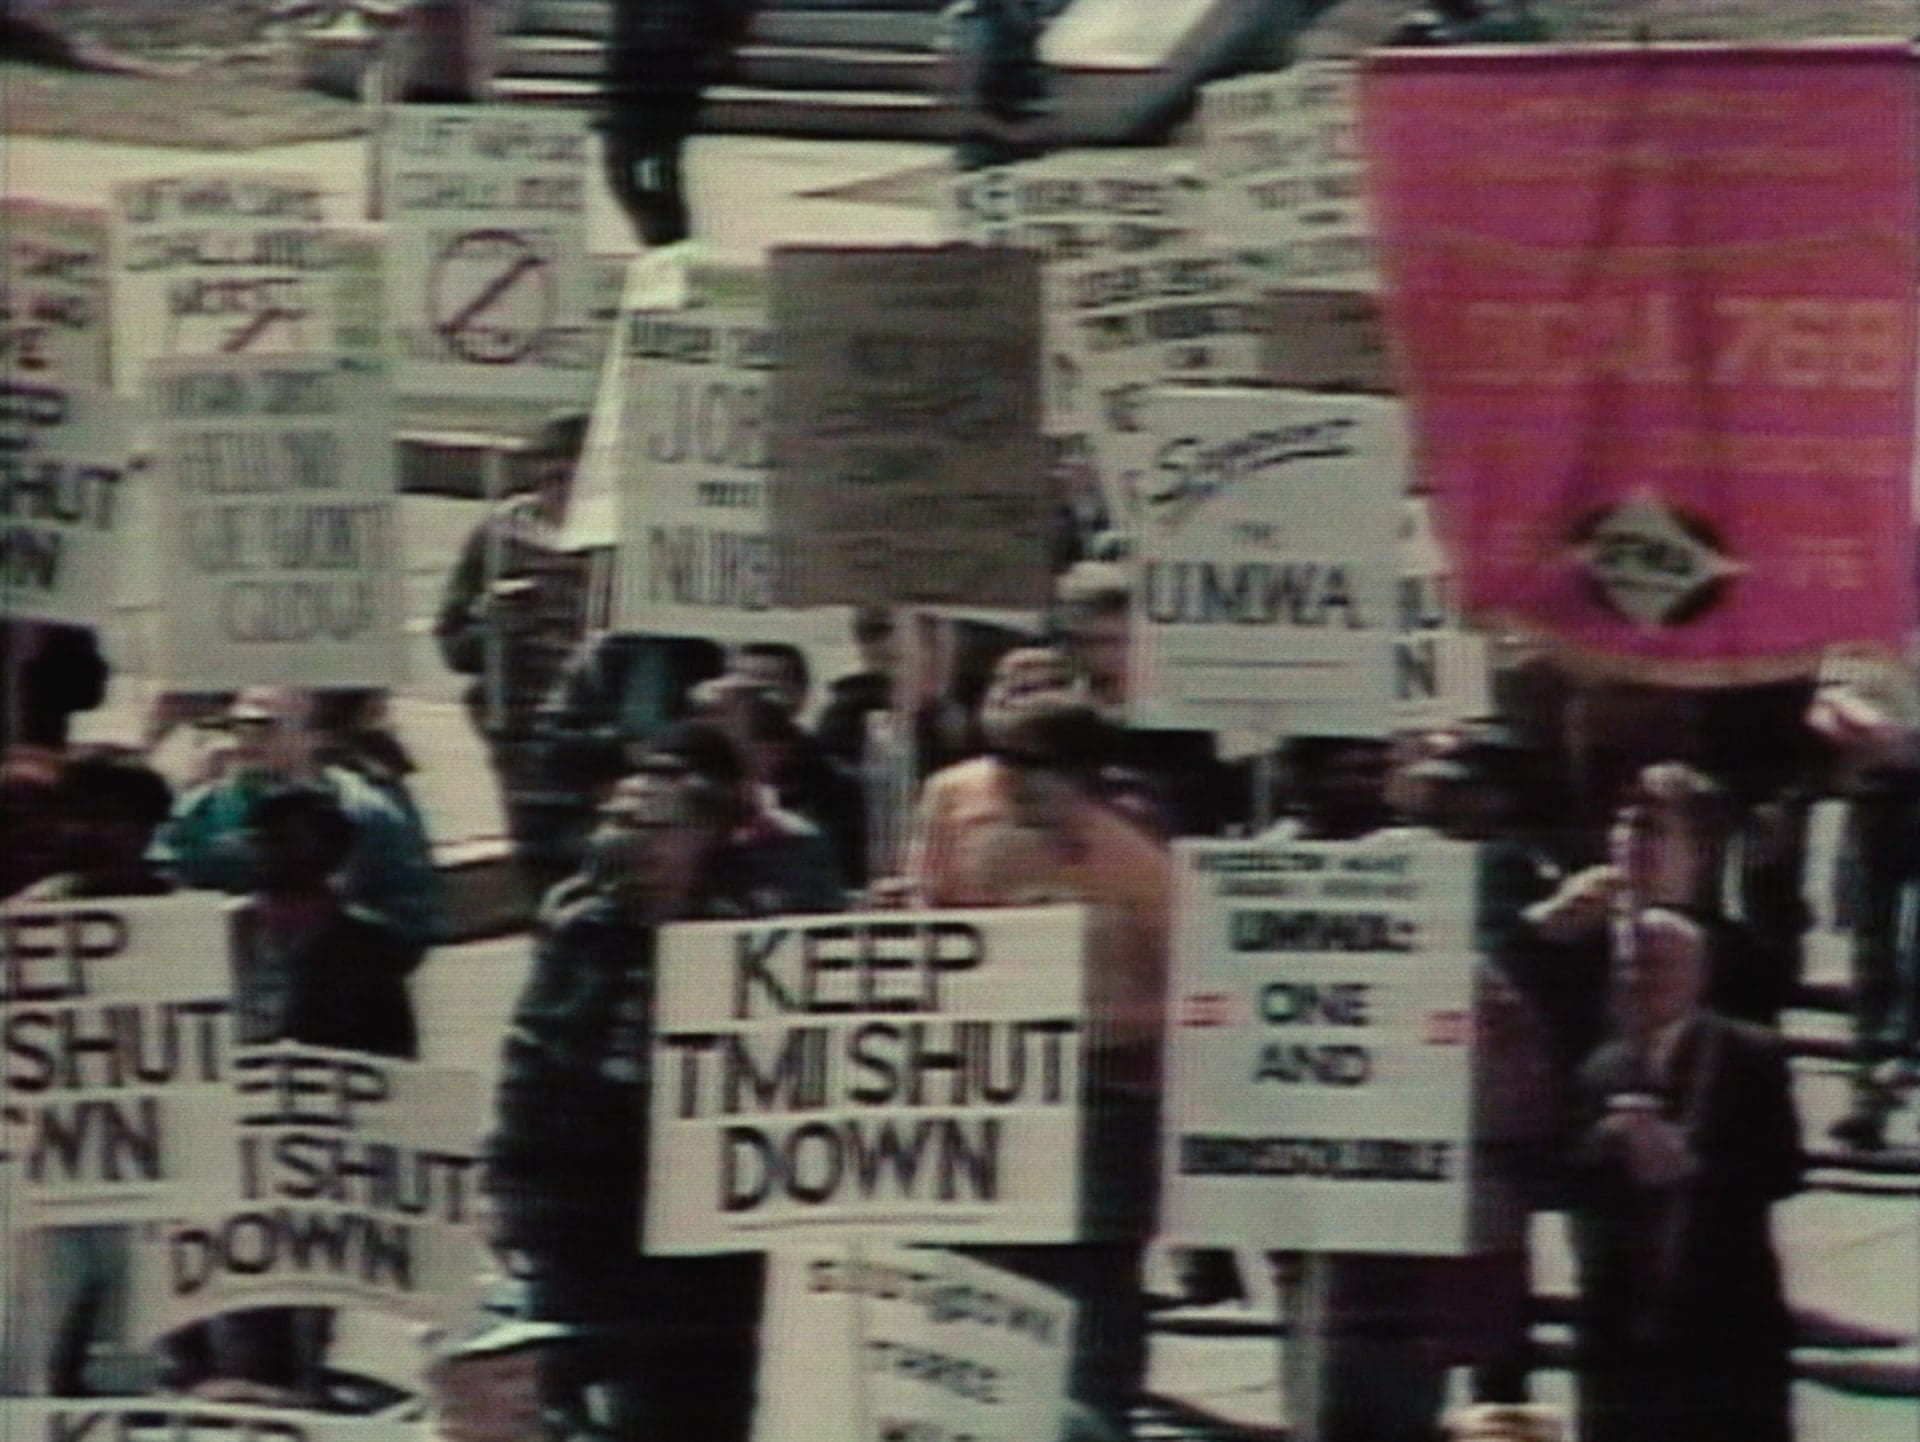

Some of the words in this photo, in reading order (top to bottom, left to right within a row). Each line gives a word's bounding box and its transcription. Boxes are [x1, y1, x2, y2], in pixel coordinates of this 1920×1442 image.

[1145, 560, 1366, 629] UMWA
[0, 908, 129, 1000] EP
[732, 922, 986, 1019] KEEP
[2, 1001, 228, 1093] SHUT
[1257, 981, 1373, 1026] ONE
[658, 1029, 829, 1119] TMI
[843, 1019, 1079, 1108] SHUT
[1252, 1042, 1372, 1087] AND
[718, 1117, 1001, 1213] DOWN
[172, 1205, 414, 1295] DOWN
